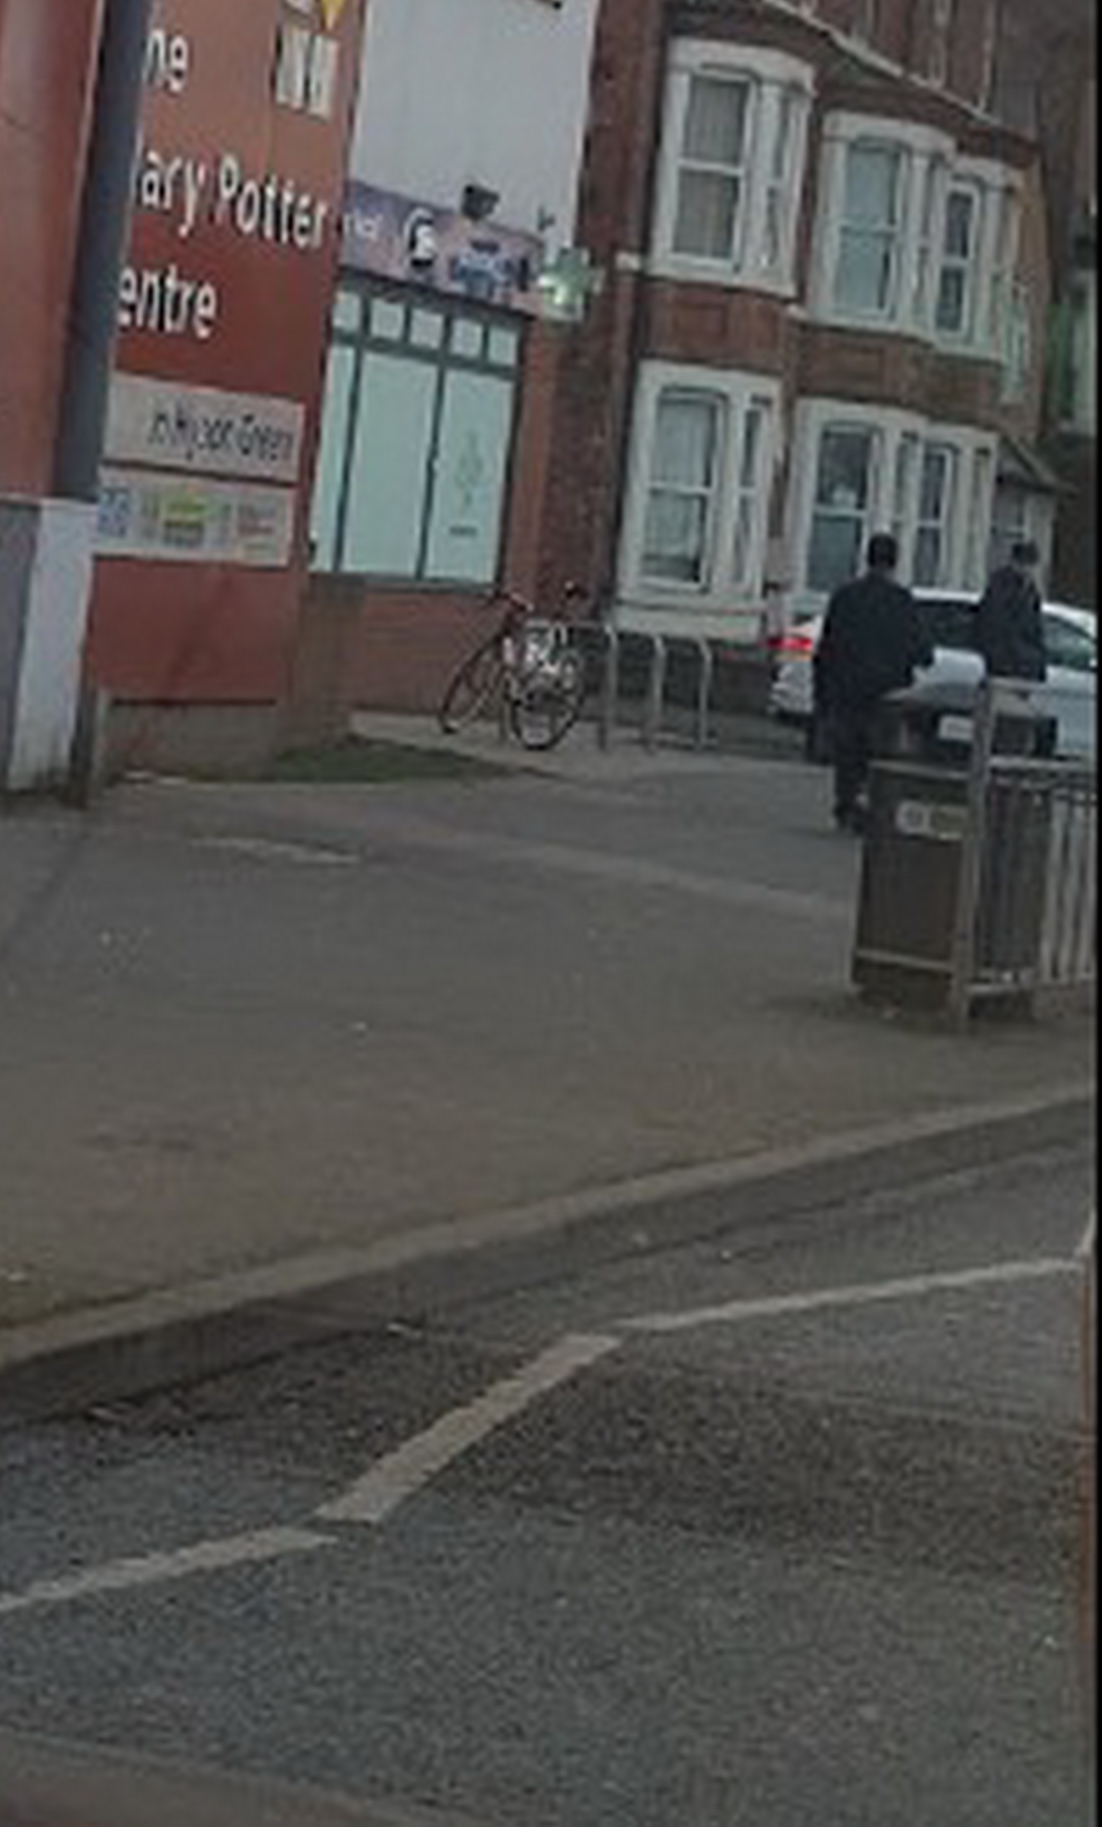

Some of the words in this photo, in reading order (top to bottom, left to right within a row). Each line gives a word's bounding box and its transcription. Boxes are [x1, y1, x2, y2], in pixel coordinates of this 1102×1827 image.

[141, 28, 189, 93] he
[136, 150, 205, 239] ary
[217, 153, 327, 249] Potter
[118, 264, 217, 340] entre
